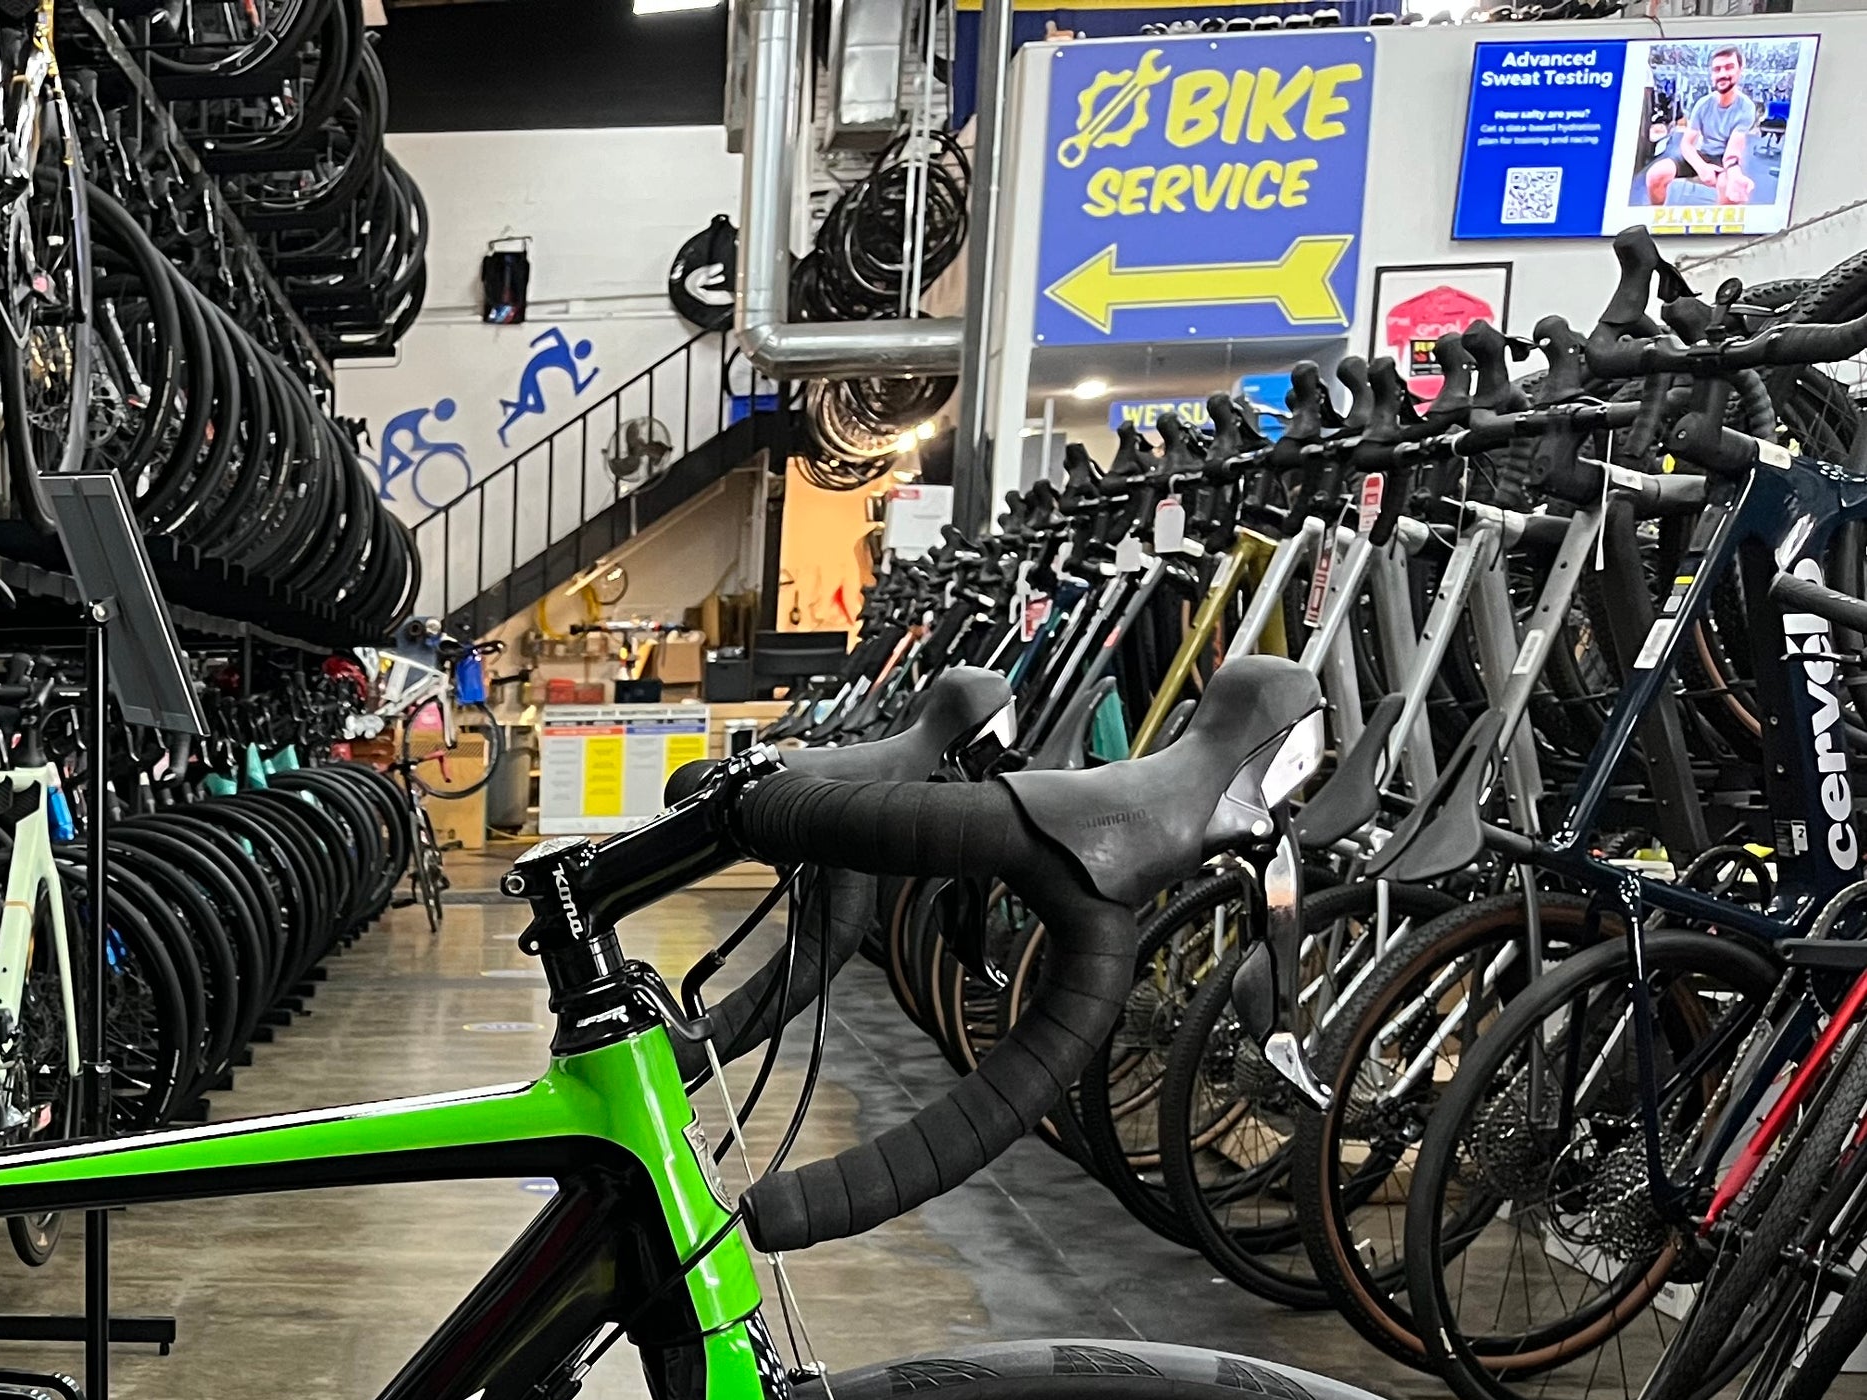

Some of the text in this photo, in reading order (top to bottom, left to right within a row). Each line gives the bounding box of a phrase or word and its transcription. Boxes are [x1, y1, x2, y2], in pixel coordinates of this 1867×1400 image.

[1501, 50, 1597, 67] Advanced
[1481, 69, 1614, 88] Sweat Testing
[1165, 62, 1363, 147] BIKE
[1082, 158, 1318, 218] SERVICE
[1652, 206, 1746, 224] PLAYTRI
